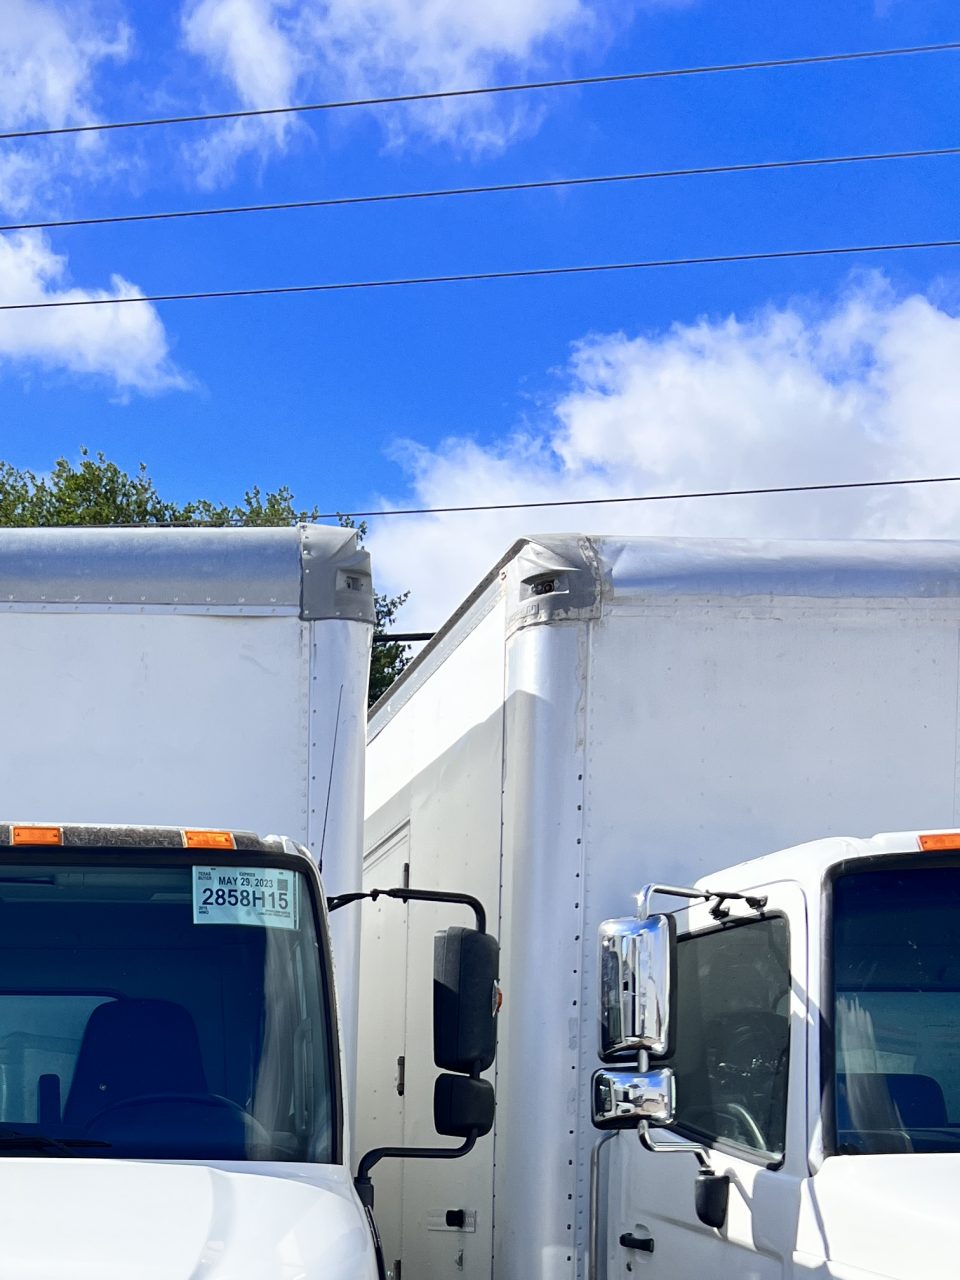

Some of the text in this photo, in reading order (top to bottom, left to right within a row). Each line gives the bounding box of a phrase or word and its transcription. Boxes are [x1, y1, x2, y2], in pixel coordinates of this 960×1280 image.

[219, 876, 274, 888] MAY 29, 2023
[202, 888, 289, 910] 2858H15
